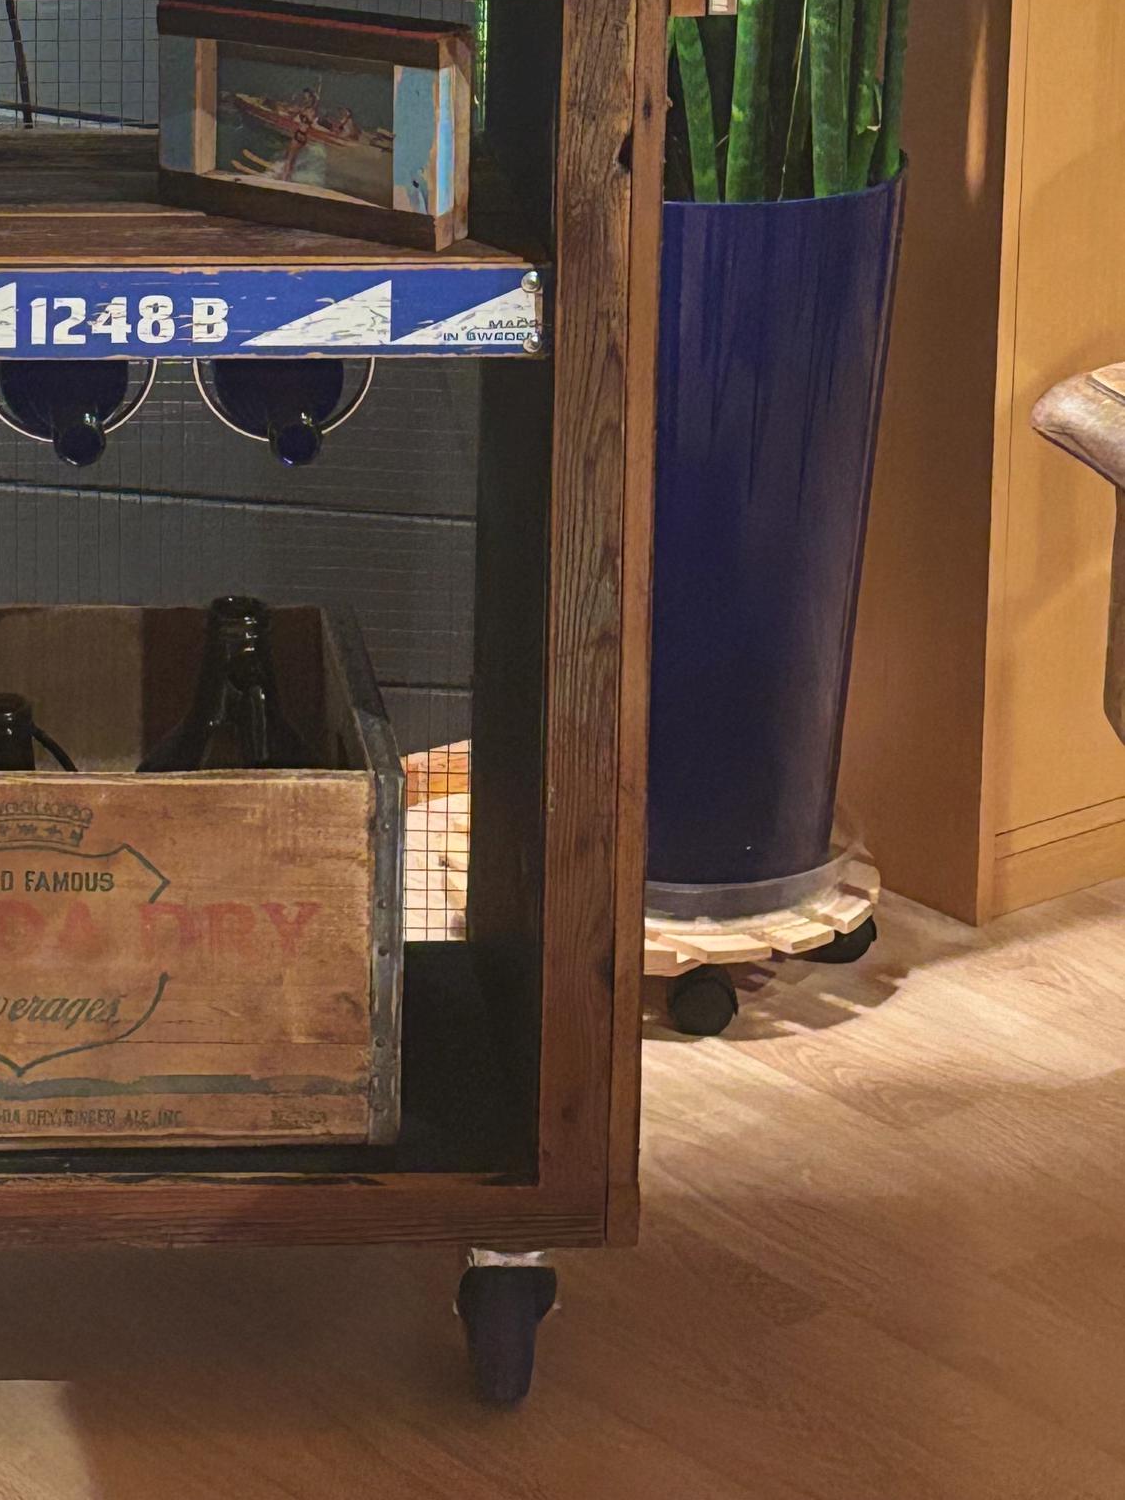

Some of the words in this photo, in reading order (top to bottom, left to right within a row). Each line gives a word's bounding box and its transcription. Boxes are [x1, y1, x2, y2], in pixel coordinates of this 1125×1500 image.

[30, 295, 175, 345] 1248
[191, 297, 229, 344] B
[443, 332, 459, 341] IN
[25, 870, 116, 893] FAMOUS
[139, 901, 322, 958] DRY
